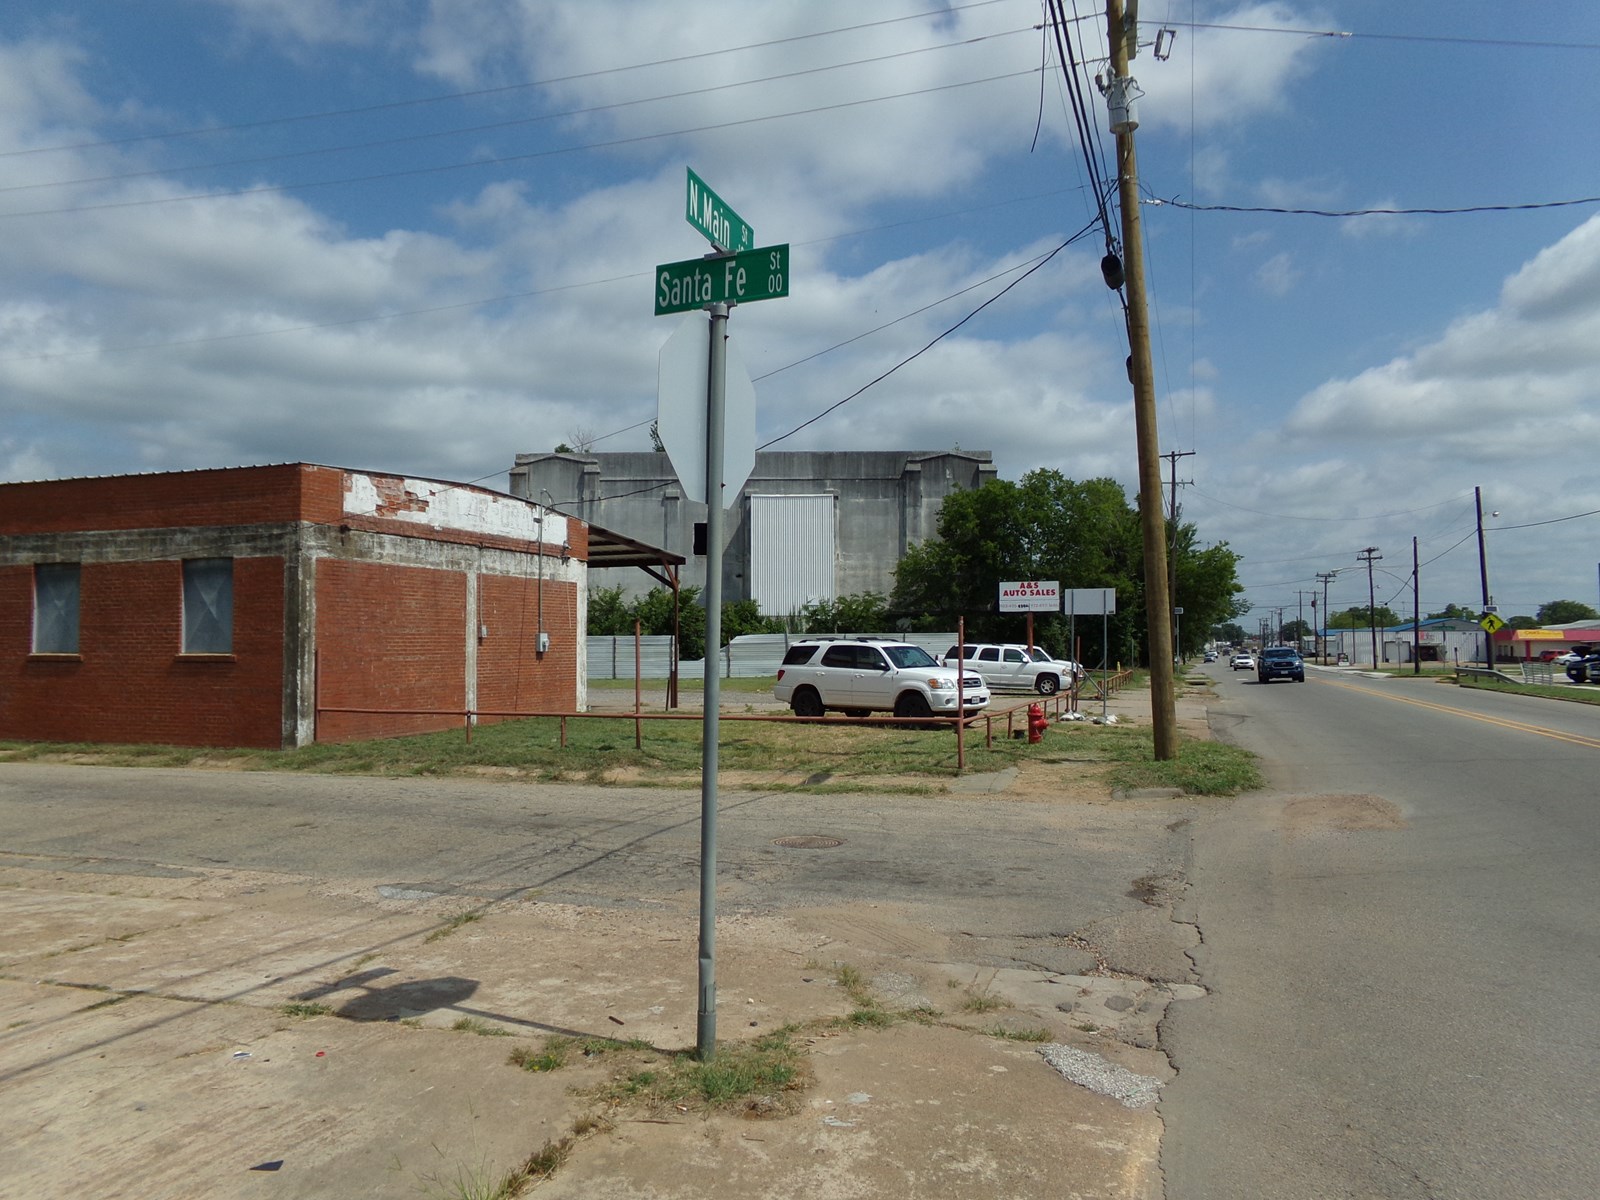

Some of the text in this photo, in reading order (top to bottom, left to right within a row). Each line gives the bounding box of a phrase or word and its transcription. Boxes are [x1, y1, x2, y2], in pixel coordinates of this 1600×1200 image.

[741, 225, 748, 244] St
[770, 251, 781, 270] St
[659, 261, 746, 308] Santa Fe
[768, 273, 782, 293] 00
[1003, 589, 1027, 597] AUTO
